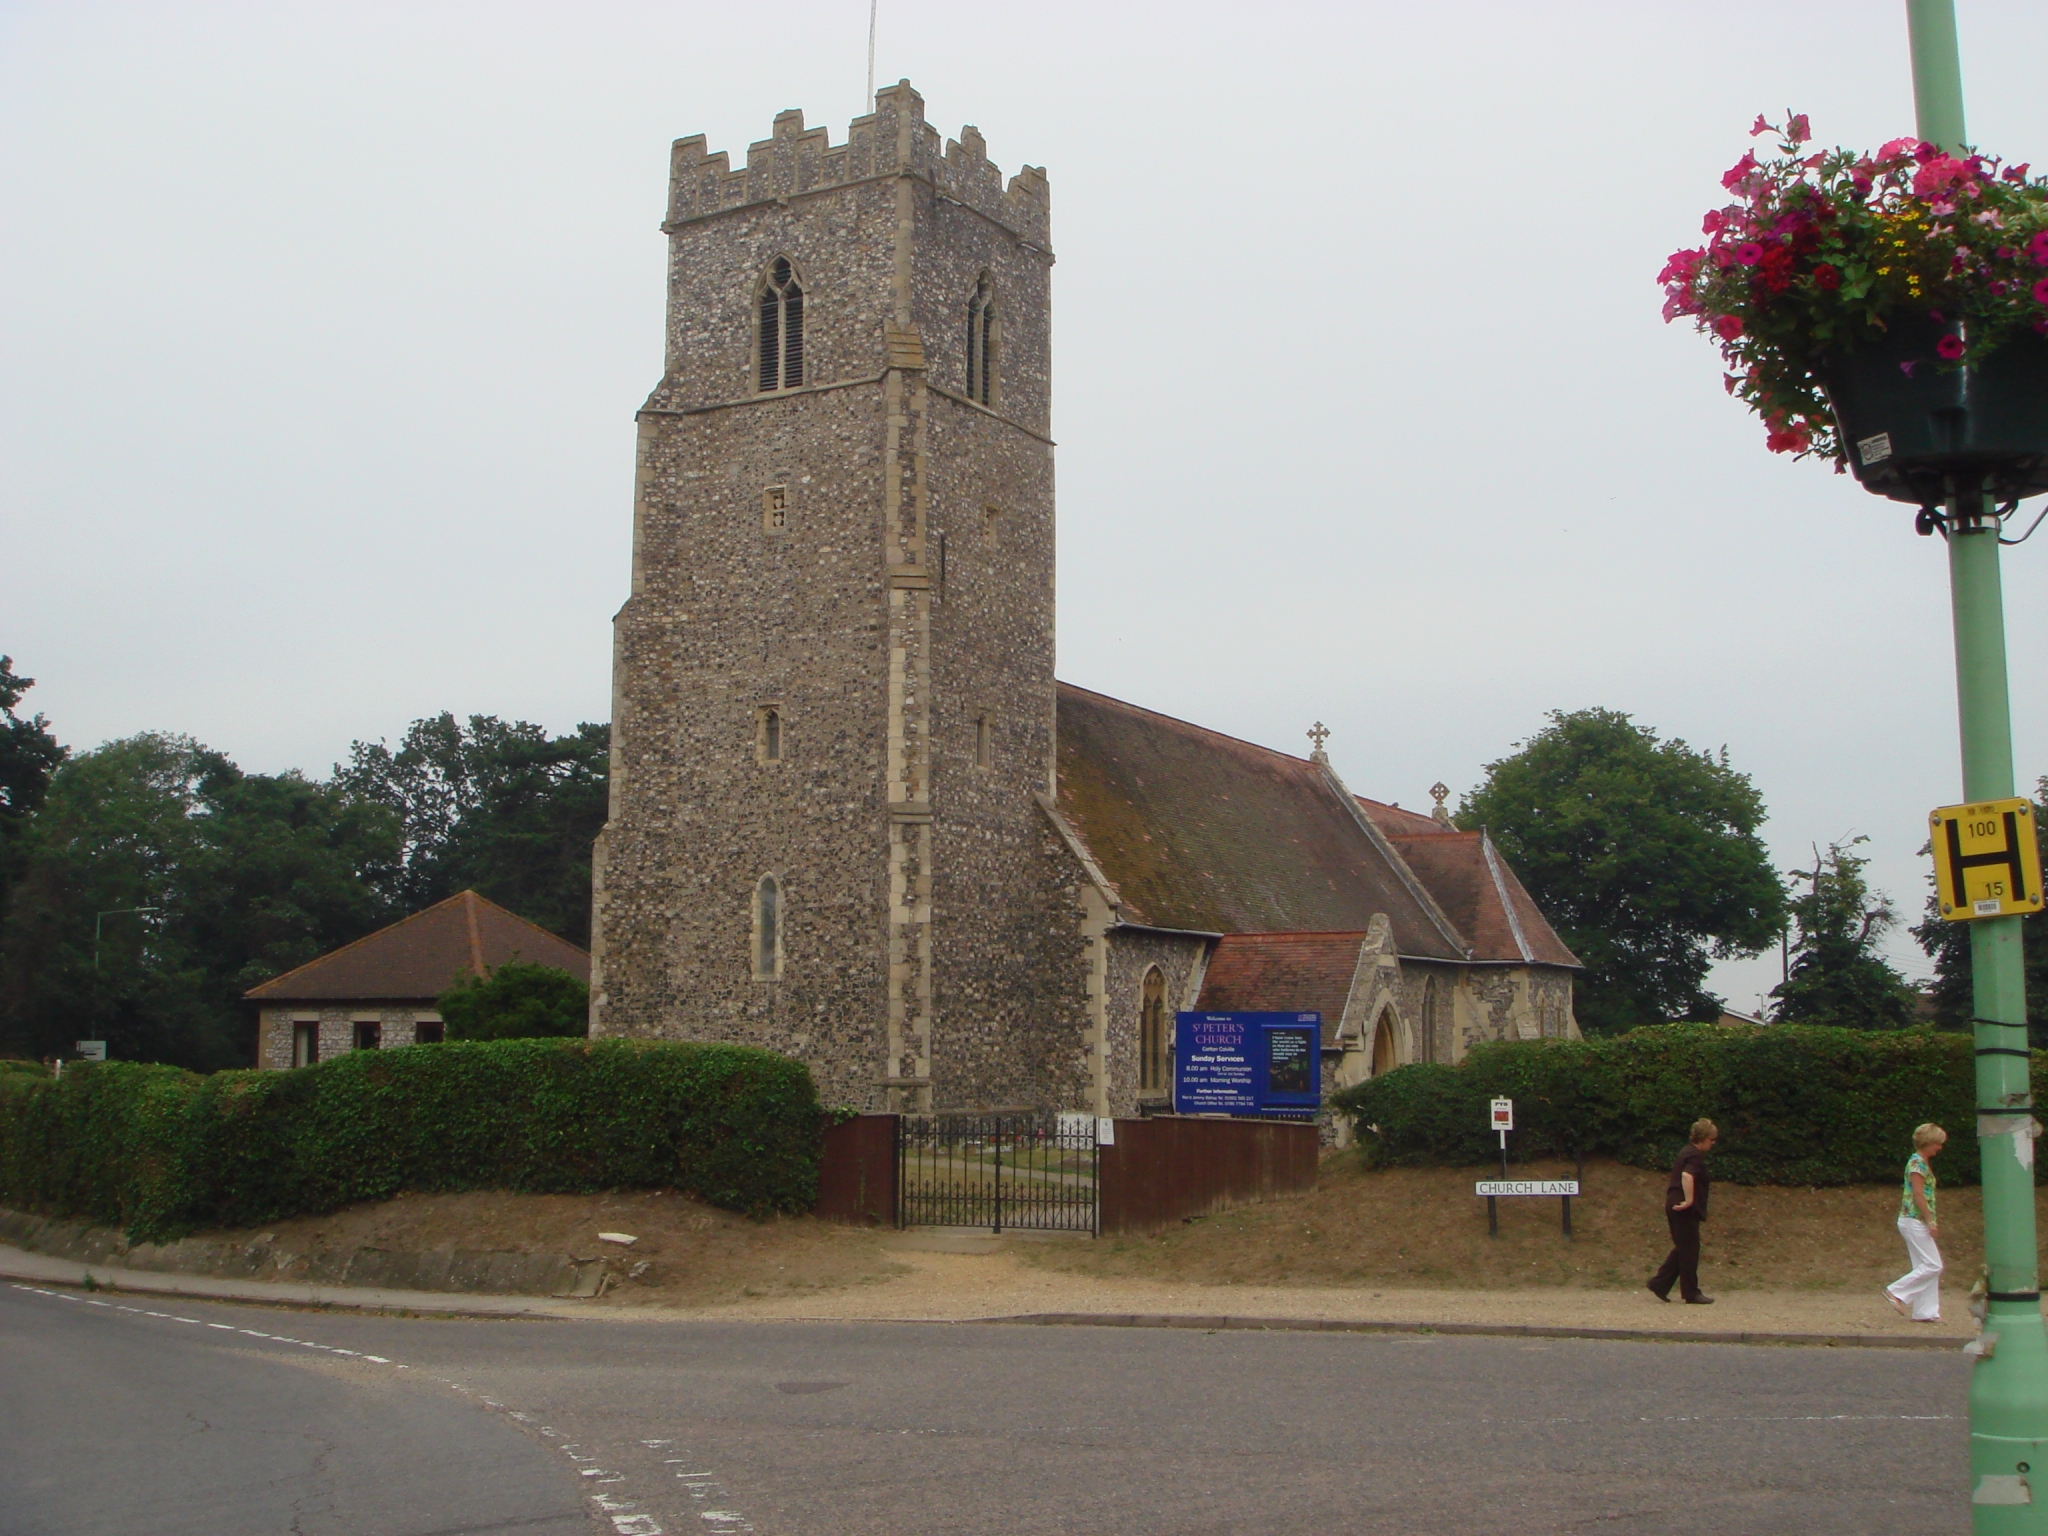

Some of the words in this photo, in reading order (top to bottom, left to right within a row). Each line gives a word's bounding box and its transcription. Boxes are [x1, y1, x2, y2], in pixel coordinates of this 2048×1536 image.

[1968, 820, 1996, 838] 100
[1985, 881, 2004, 898] 15
[1203, 1023, 1245, 1033] PETER'S
[1195, 1035, 1242, 1045] CHURCH
[1191, 1055, 1215, 1063] Sunday
[1210, 1065, 1221, 1073] Holy
[1480, 1183, 1533, 1194] CHURCH
[1541, 1182, 1574, 1194] LANE
